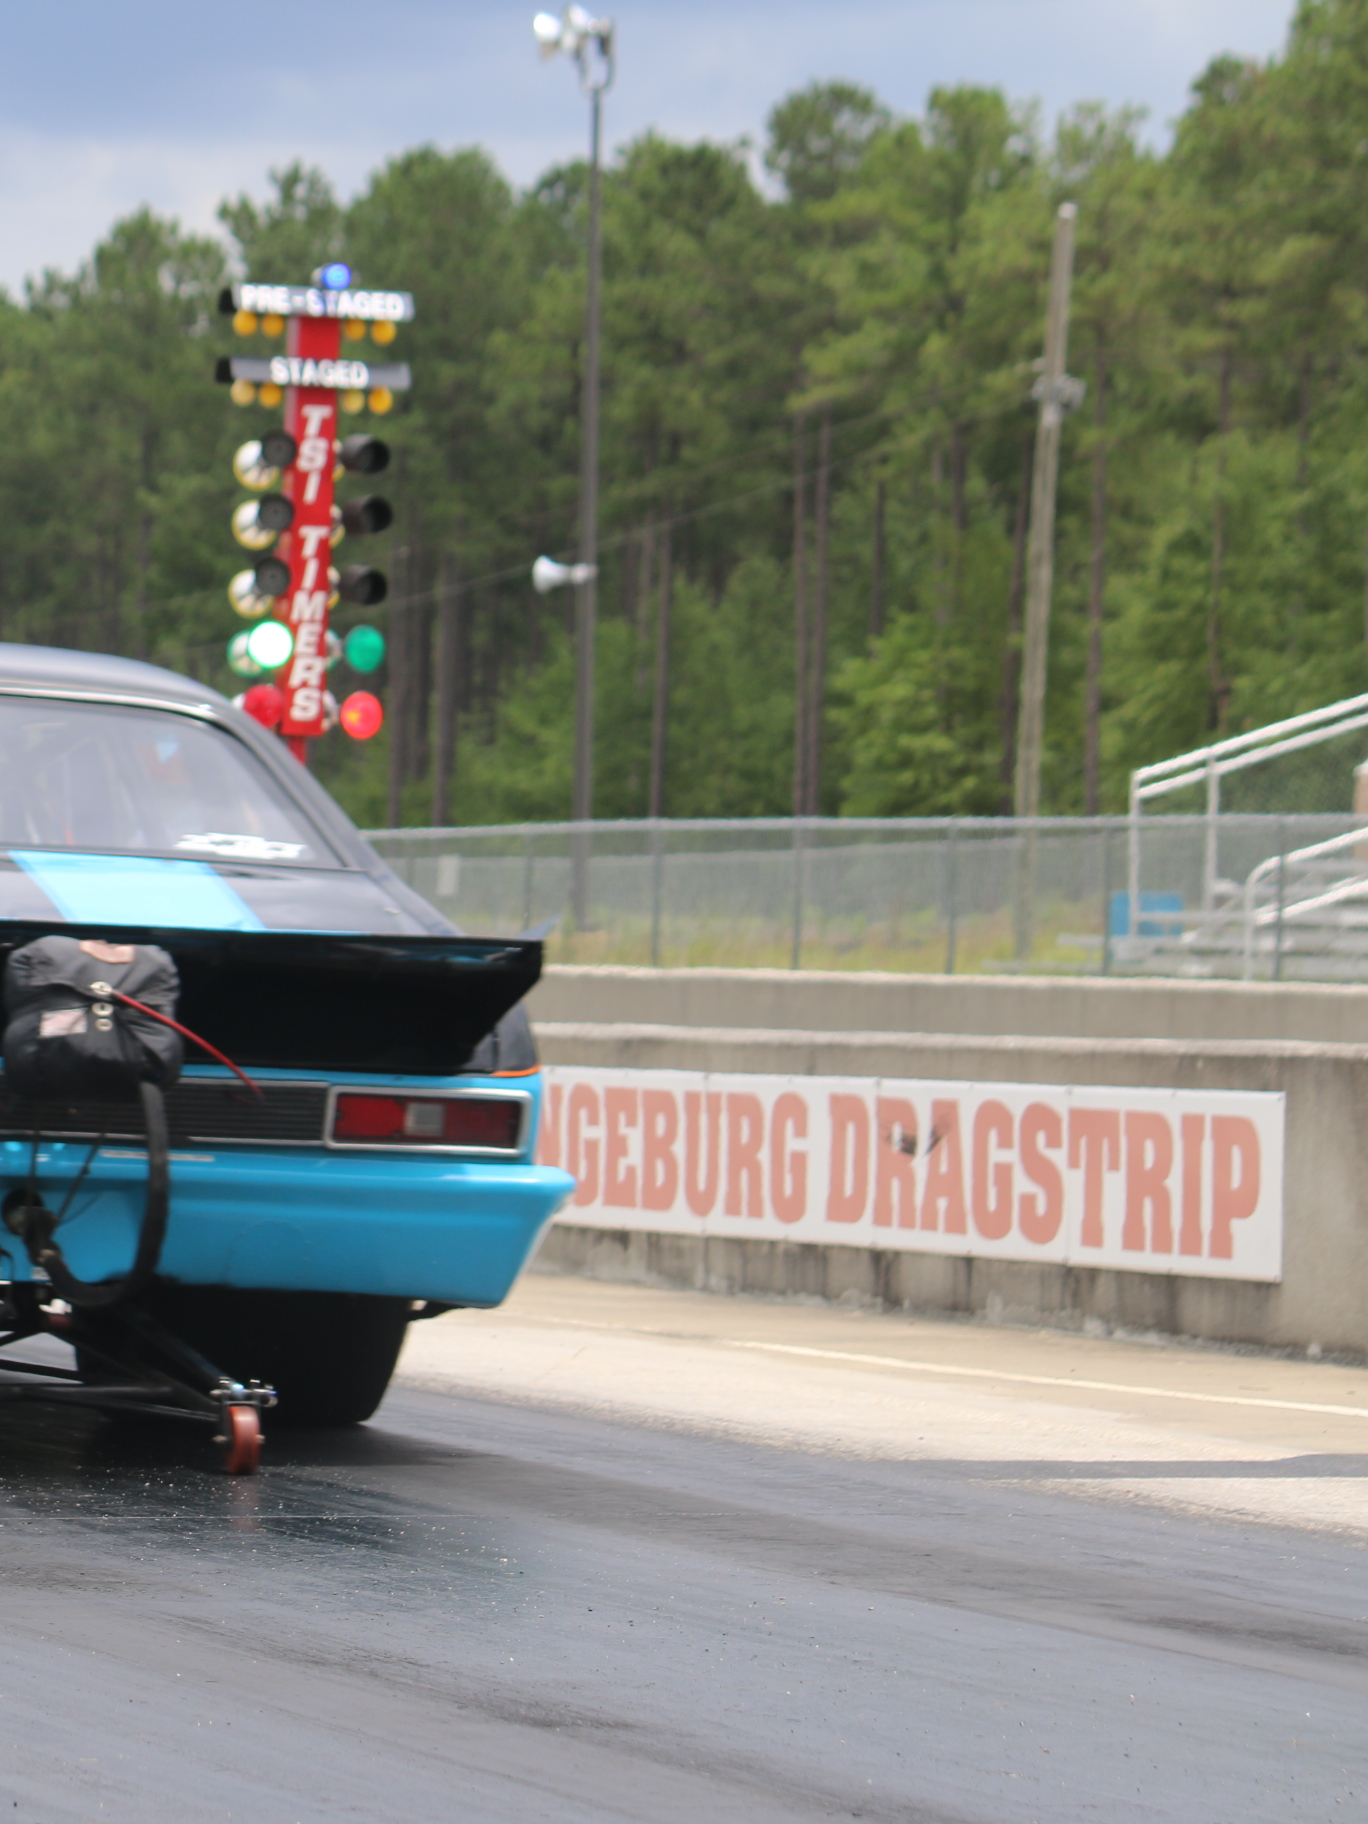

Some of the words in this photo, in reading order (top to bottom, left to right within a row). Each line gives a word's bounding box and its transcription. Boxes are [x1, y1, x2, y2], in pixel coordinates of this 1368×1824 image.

[240, 284, 405, 319] PRE-STAGED
[270, 355, 369, 388] STAGED
[296, 404, 334, 504] TSI
[289, 525, 330, 722] TIMERS
[825, 1092, 1261, 1260] DRAGSTRIP
